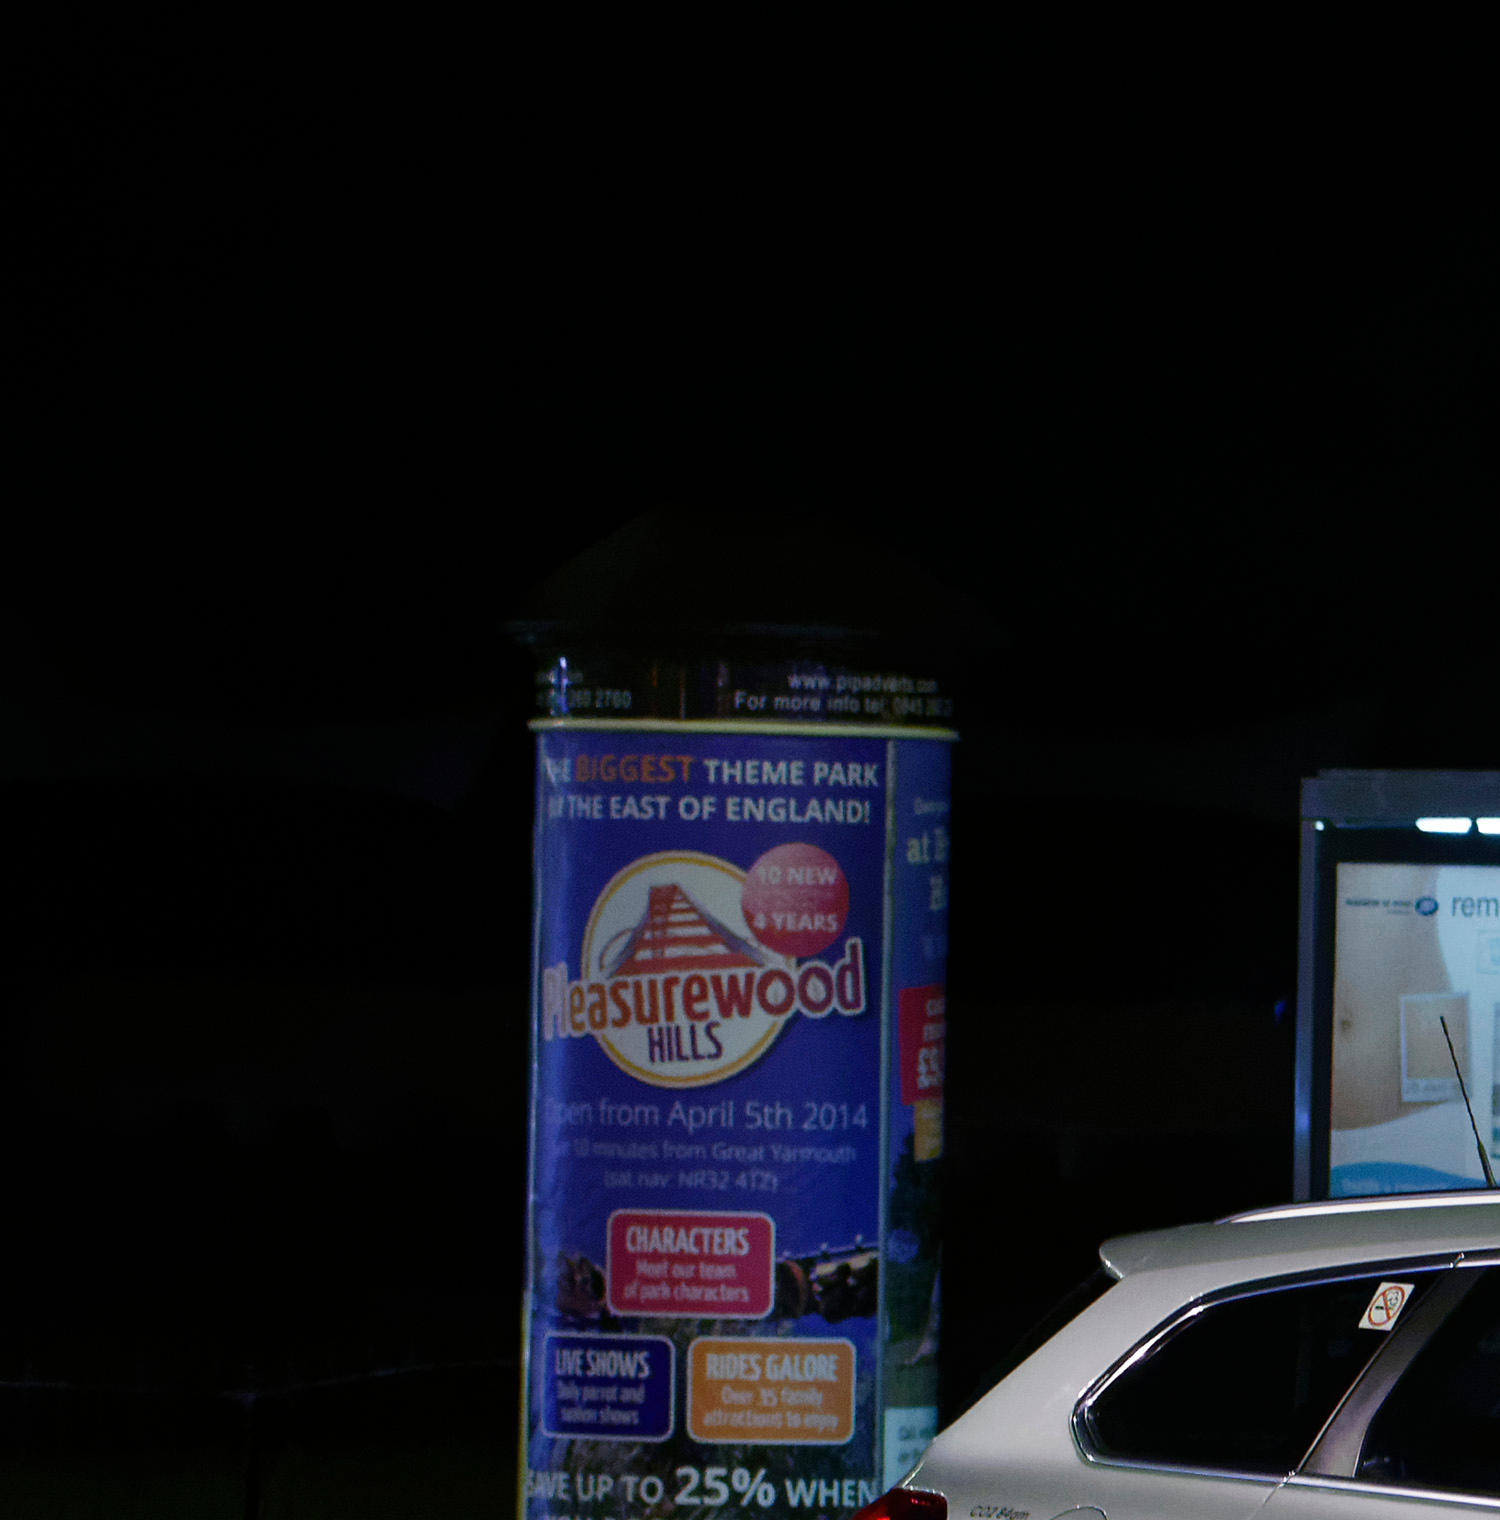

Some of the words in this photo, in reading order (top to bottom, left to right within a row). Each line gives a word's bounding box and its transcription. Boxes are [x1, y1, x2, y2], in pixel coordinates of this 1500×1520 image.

[576, 753, 695, 783] BIGGEST
[704, 757, 805, 786] THEME
[813, 761, 878, 787] PARK
[567, 794, 602, 819] THE
[609, 795, 671, 820] EAST
[678, 796, 717, 822] OF
[726, 796, 871, 824] ENGLAND!
[786, 866, 838, 886] NEW
[771, 911, 838, 933] YEARS
[648, 1020, 723, 1063] HILLS
[600, 1097, 660, 1126] from
[667, 1100, 734, 1135] April
[745, 1100, 793, 1130] 5th
[802, 1101, 868, 1131] 2014
[625, 1225, 751, 1256] CHARACTERS
[585, 1348, 650, 1379] SHOWS
[705, 1352, 763, 1382] RIDES
[765, 1353, 840, 1383] GALORE
[576, 1472, 614, 1501] UP
[620, 1474, 664, 1505] TO
[674, 1465, 776, 1508] 25%
[785, 1478, 879, 1509] WHEN
